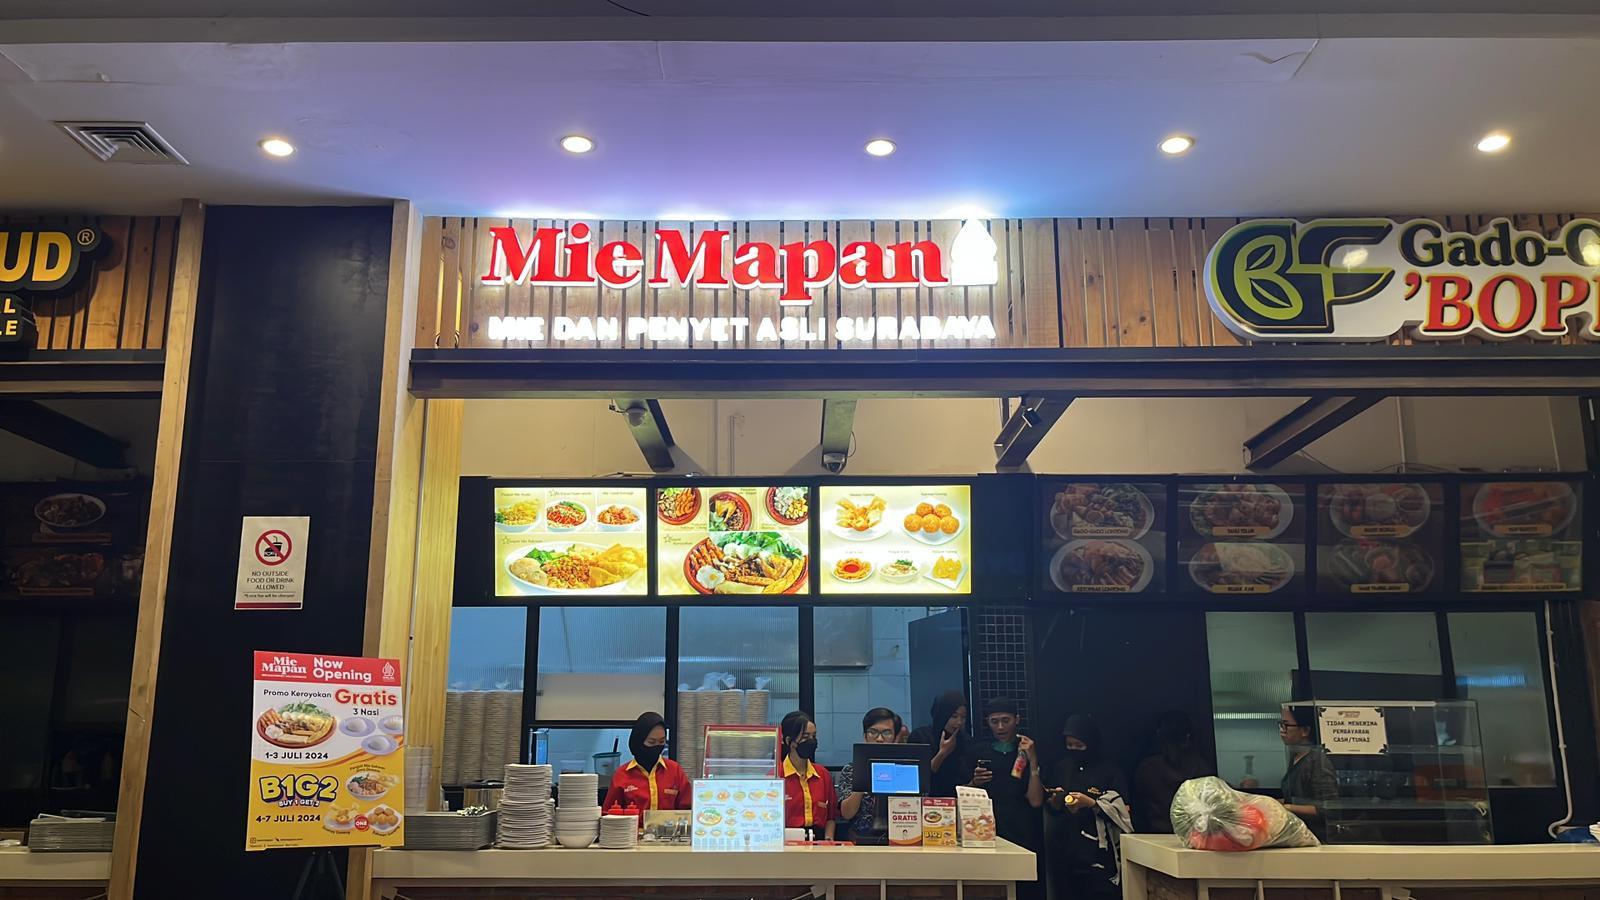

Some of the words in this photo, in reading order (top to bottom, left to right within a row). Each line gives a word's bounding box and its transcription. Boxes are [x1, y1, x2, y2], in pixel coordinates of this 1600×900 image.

[482, 222, 644, 288] Mie
[649, 229, 949, 306] Mapan
[1404, 272, 1600, 334] 'BOP
[488, 316, 545, 340] MIE
[554, 316, 618, 341] DAN
[628, 316, 749, 341] PENYET
[756, 316, 826, 342] ASLI
[835, 315, 997, 341] SURABAYA
[261, 662, 307, 674] Mapan
[273, 656, 297, 666] Mie
[314, 657, 343, 669] Now
[312, 668, 372, 682] Opening
[263, 689, 289, 697] Promo
[291, 690, 332, 699] Keroyokan
[335, 688, 397, 706] Gratis
[361, 708, 379, 716] Nasi
[259, 773, 339, 803] B1G2
